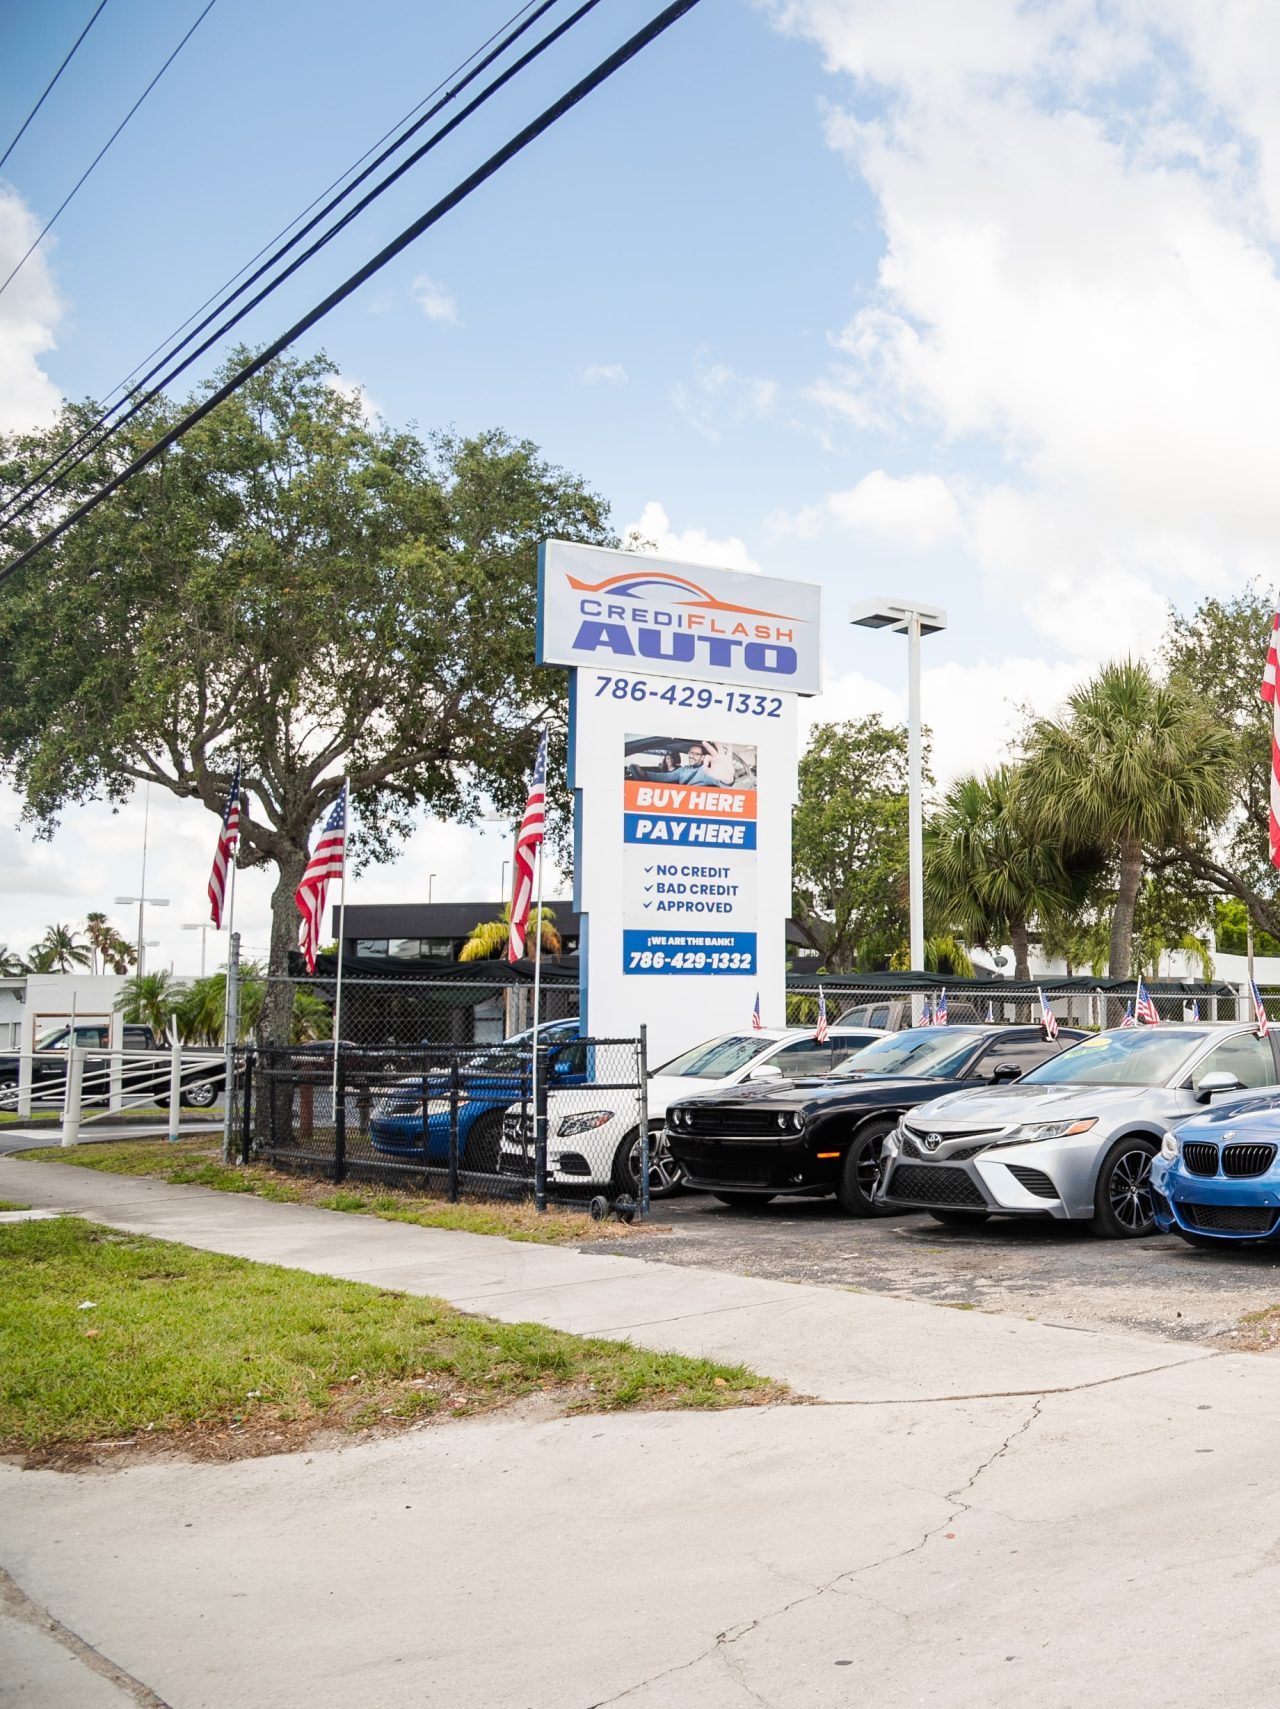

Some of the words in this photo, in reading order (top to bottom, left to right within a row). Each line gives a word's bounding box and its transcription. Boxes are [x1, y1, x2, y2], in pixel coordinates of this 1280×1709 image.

[580, 599, 793, 642] CREDIFLASH
[571, 620, 797, 675] AUTO
[594, 676, 783, 718] 786-429-1332
[636, 787, 687, 808] BUY
[688, 791, 746, 813] HERE
[636, 819, 687, 840] PAY
[688, 823, 746, 844] HERE
[656, 864, 678, 876] NO
[681, 866, 730, 878] CREDIT
[656, 882, 686, 894] BAD
[690, 884, 739, 896] CREDIT
[656, 900, 733, 913] APPROVED
[668, 937, 686, 946] ARE
[686, 937, 705, 946] THE
[705, 938, 735, 946] BANK!
[629, 951, 752, 969] 786-429-1332
